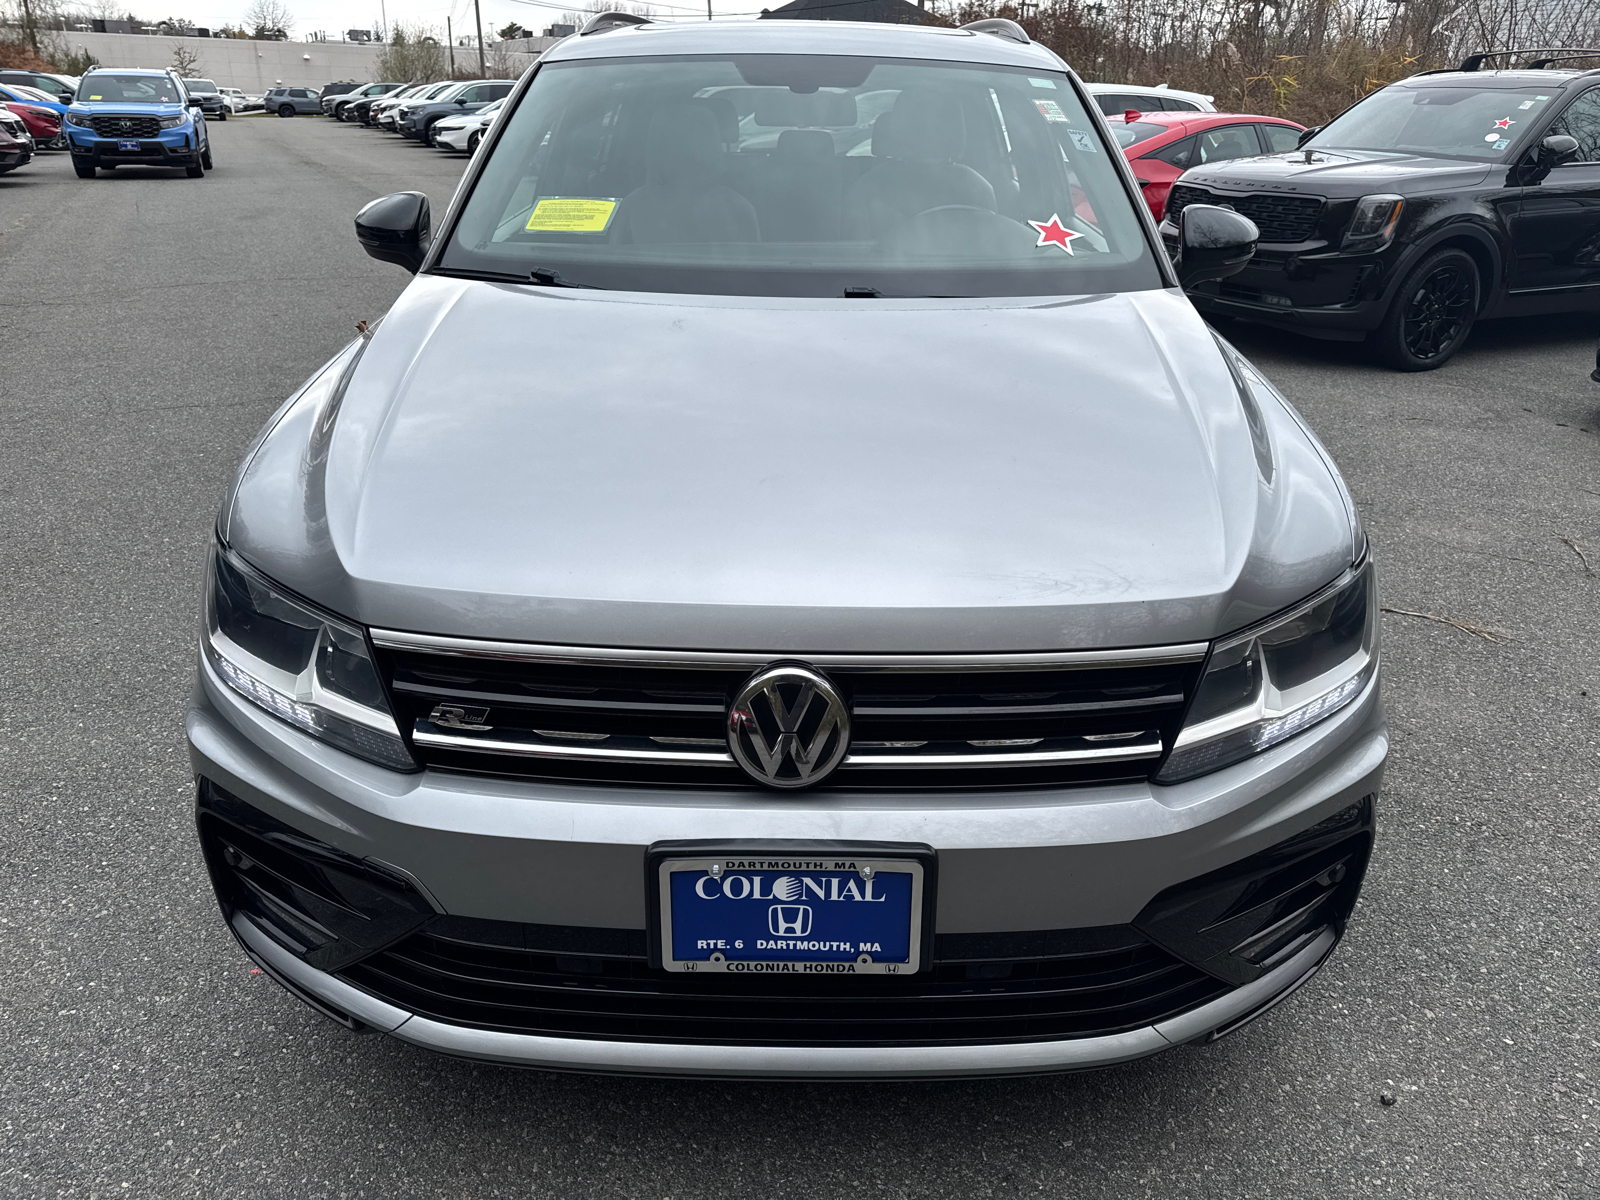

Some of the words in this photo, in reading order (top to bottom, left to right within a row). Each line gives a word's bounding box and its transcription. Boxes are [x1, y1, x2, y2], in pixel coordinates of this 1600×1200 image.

[725, 861, 829, 870] DARTMOUTH,
[833, 862, 857, 870] MA
[695, 876, 886, 902] COLONIAL
[697, 939, 731, 949] RTE.
[734, 939, 744, 949] 6
[756, 939, 855, 953] DARTMOUTH,
[859, 942, 882, 952] MA
[726, 962, 799, 972] COLONIAL
[803, 963, 856, 973] HONDA
